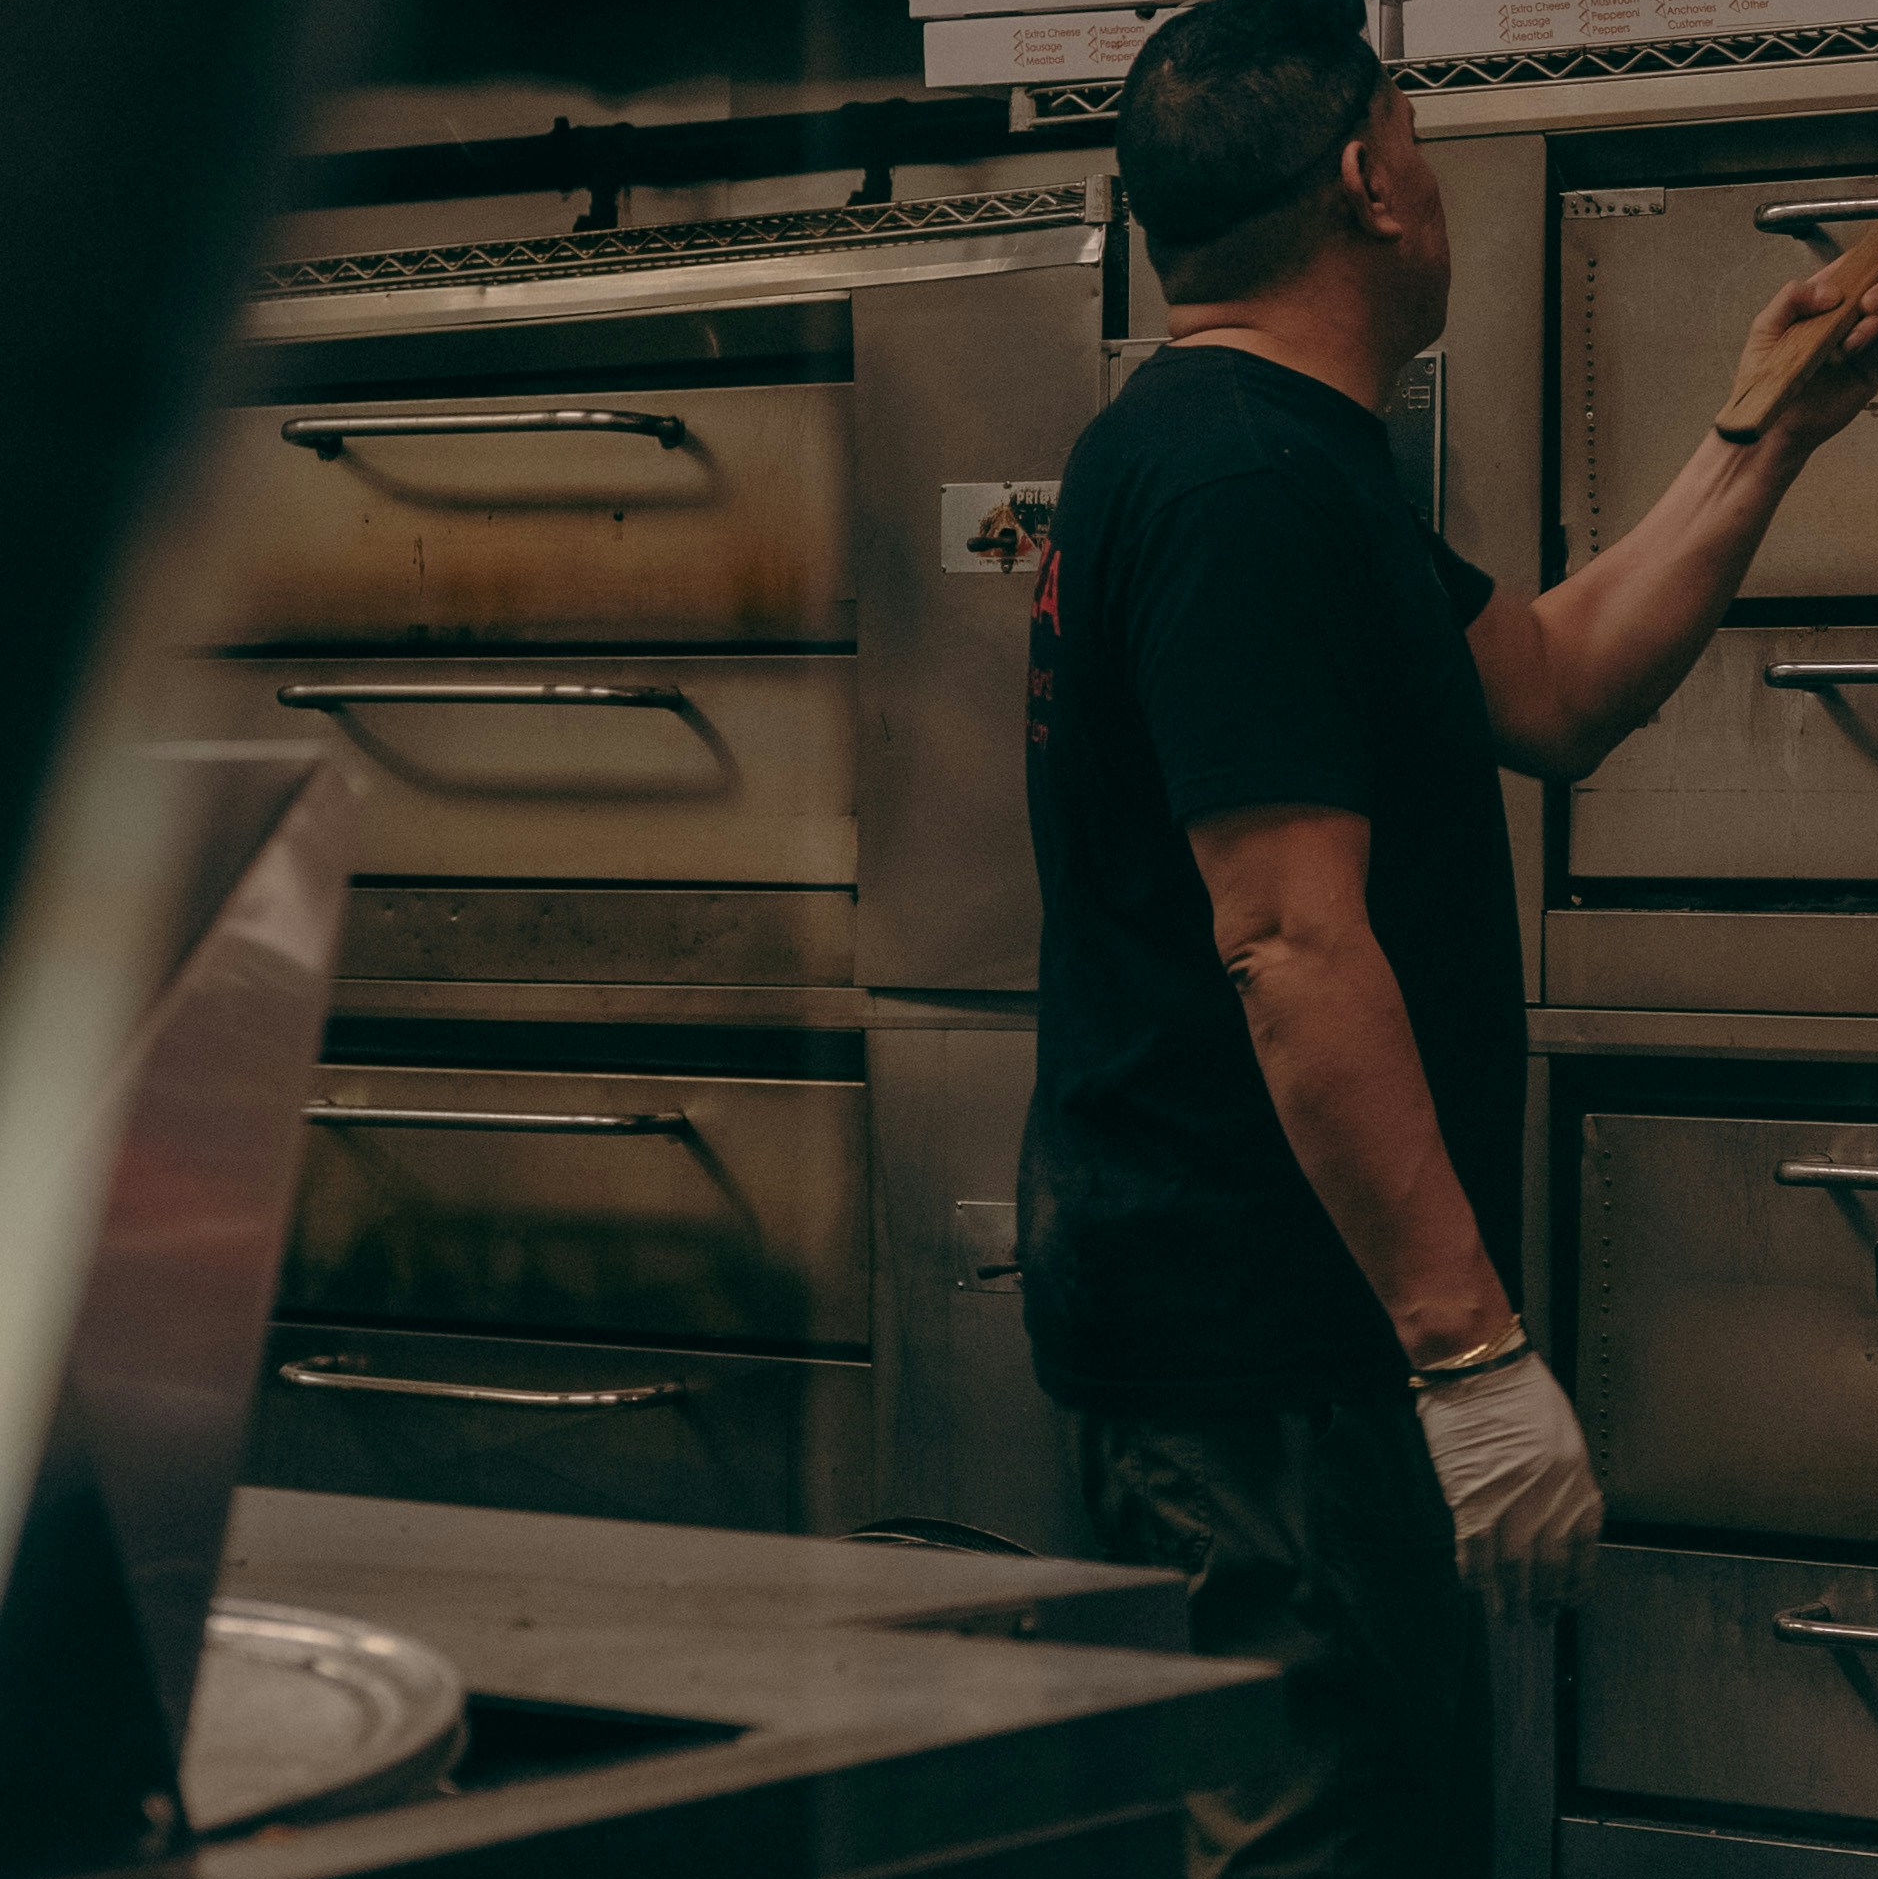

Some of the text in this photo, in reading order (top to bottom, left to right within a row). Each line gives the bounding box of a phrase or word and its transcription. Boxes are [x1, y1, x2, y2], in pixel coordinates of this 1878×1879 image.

[1511, 1, 1570, 15] Extra Cheese
[1667, 3, 1717, 15] Anchovies
[1741, 0, 1769, 10] Other
[1591, 8, 1640, 22] Pepperoni
[1511, 17, 1551, 30] Sausage
[1592, 23, 1630, 35] Peppers
[1668, 18, 1714, 30] Customer
[1025, 27, 1081, 40] Extra Cheese
[1099, 25, 1145, 36] Mushroom
[1512, 29, 1554, 42] Meatball
[1025, 41, 1062, 54] Sausage
[1026, 54, 1065, 66] Meatball
